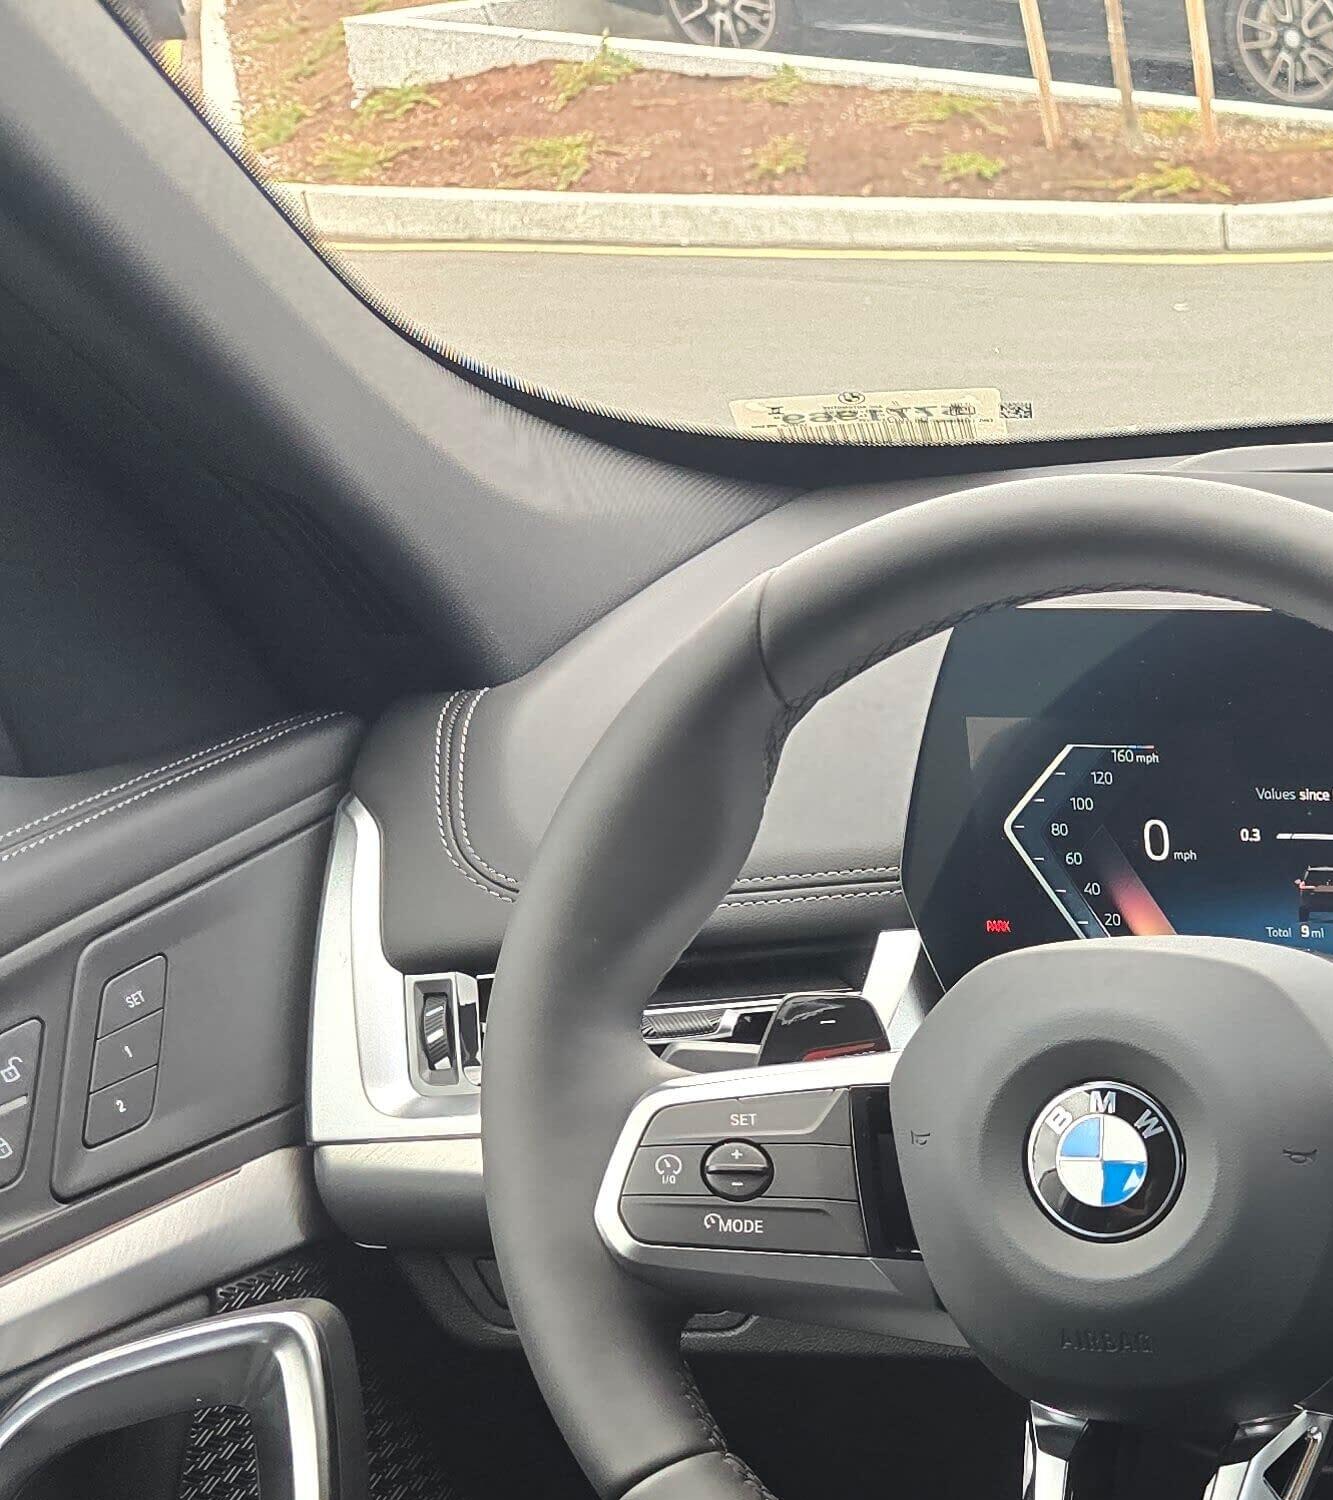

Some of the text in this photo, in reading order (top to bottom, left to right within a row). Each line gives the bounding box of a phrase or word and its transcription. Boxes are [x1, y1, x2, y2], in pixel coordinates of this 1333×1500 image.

[1111, 749, 1159, 764] 160 mph
[1091, 772, 1113, 784] 120
[1256, 787, 1296, 800] Values
[1299, 789, 1330, 801] since
[1070, 798, 1093, 810] 100
[1051, 823, 1068, 835] 80
[1240, 828, 1260, 842] 0.3
[1143, 819, 1196, 860] 0 mph
[1065, 852, 1082, 864] 60
[1084, 883, 1100, 895] 40
[1104, 914, 1120, 925] 20
[986, 920, 1011, 932] PARK
[1265, 925, 1324, 938] Total 9 mi
[126, 990, 145, 1008] SET
[116, 1100, 127, 1112] 2
[730, 1112, 755, 1126] SET
[718, 1219, 763, 1233] MODE
